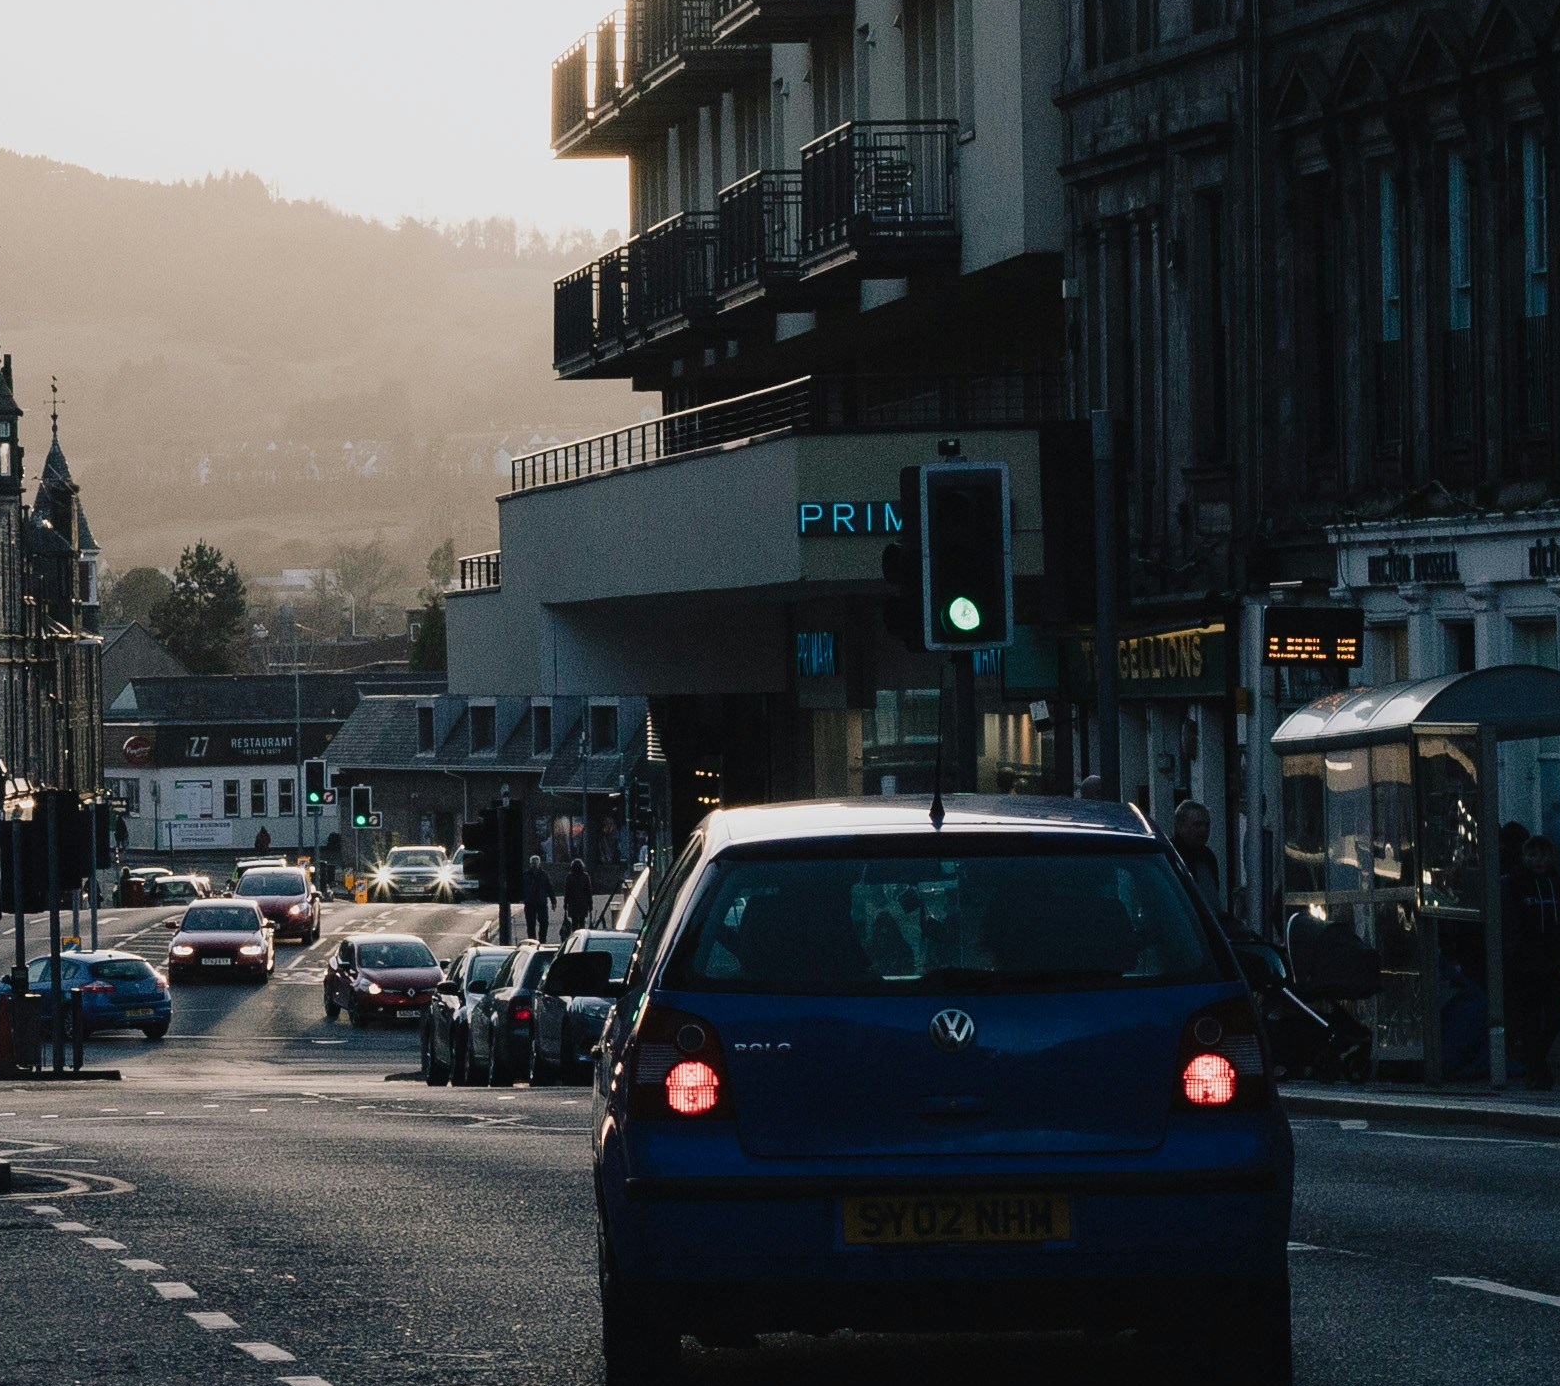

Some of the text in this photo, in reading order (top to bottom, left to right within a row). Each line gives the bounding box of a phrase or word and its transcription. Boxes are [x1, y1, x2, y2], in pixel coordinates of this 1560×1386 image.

[1368, 548, 1459, 583] HECTOR RUSSELL
[797, 631, 836, 676] PRIMARK
[1118, 634, 1203, 680] GELLIONS
[230, 737, 293, 749] RESTAURANT
[859, 1199, 1052, 1237] SY02 NHM
